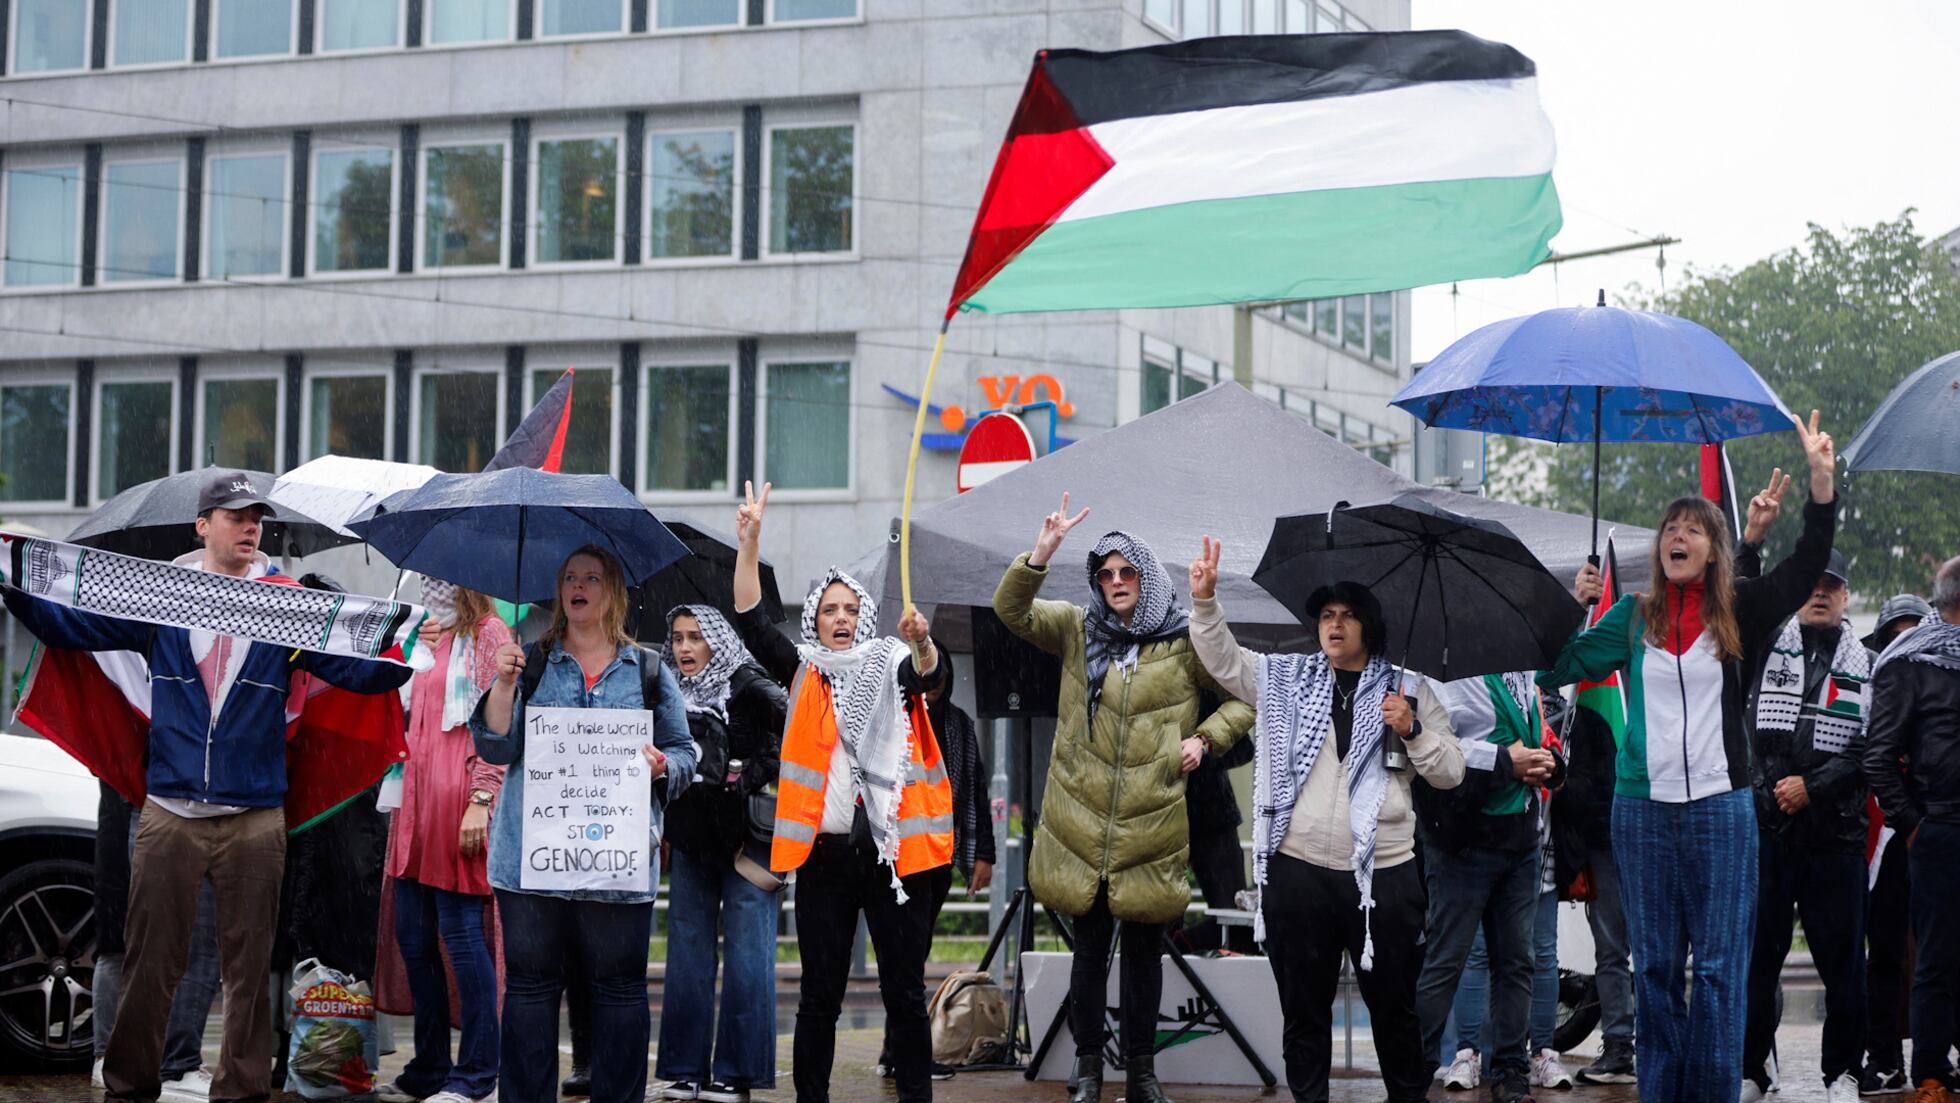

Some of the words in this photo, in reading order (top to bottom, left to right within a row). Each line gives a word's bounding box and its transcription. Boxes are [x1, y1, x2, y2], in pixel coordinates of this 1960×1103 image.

[529, 714, 560, 736] The
[553, 740, 566, 754] is
[558, 764, 578, 778] #1
[592, 763, 621, 786] thing
[626, 765, 641, 778] to
[560, 783, 608, 799] decide
[531, 805, 570, 819] ACT
[584, 804, 633, 817] TODAY:
[567, 822, 615, 842] STOP
